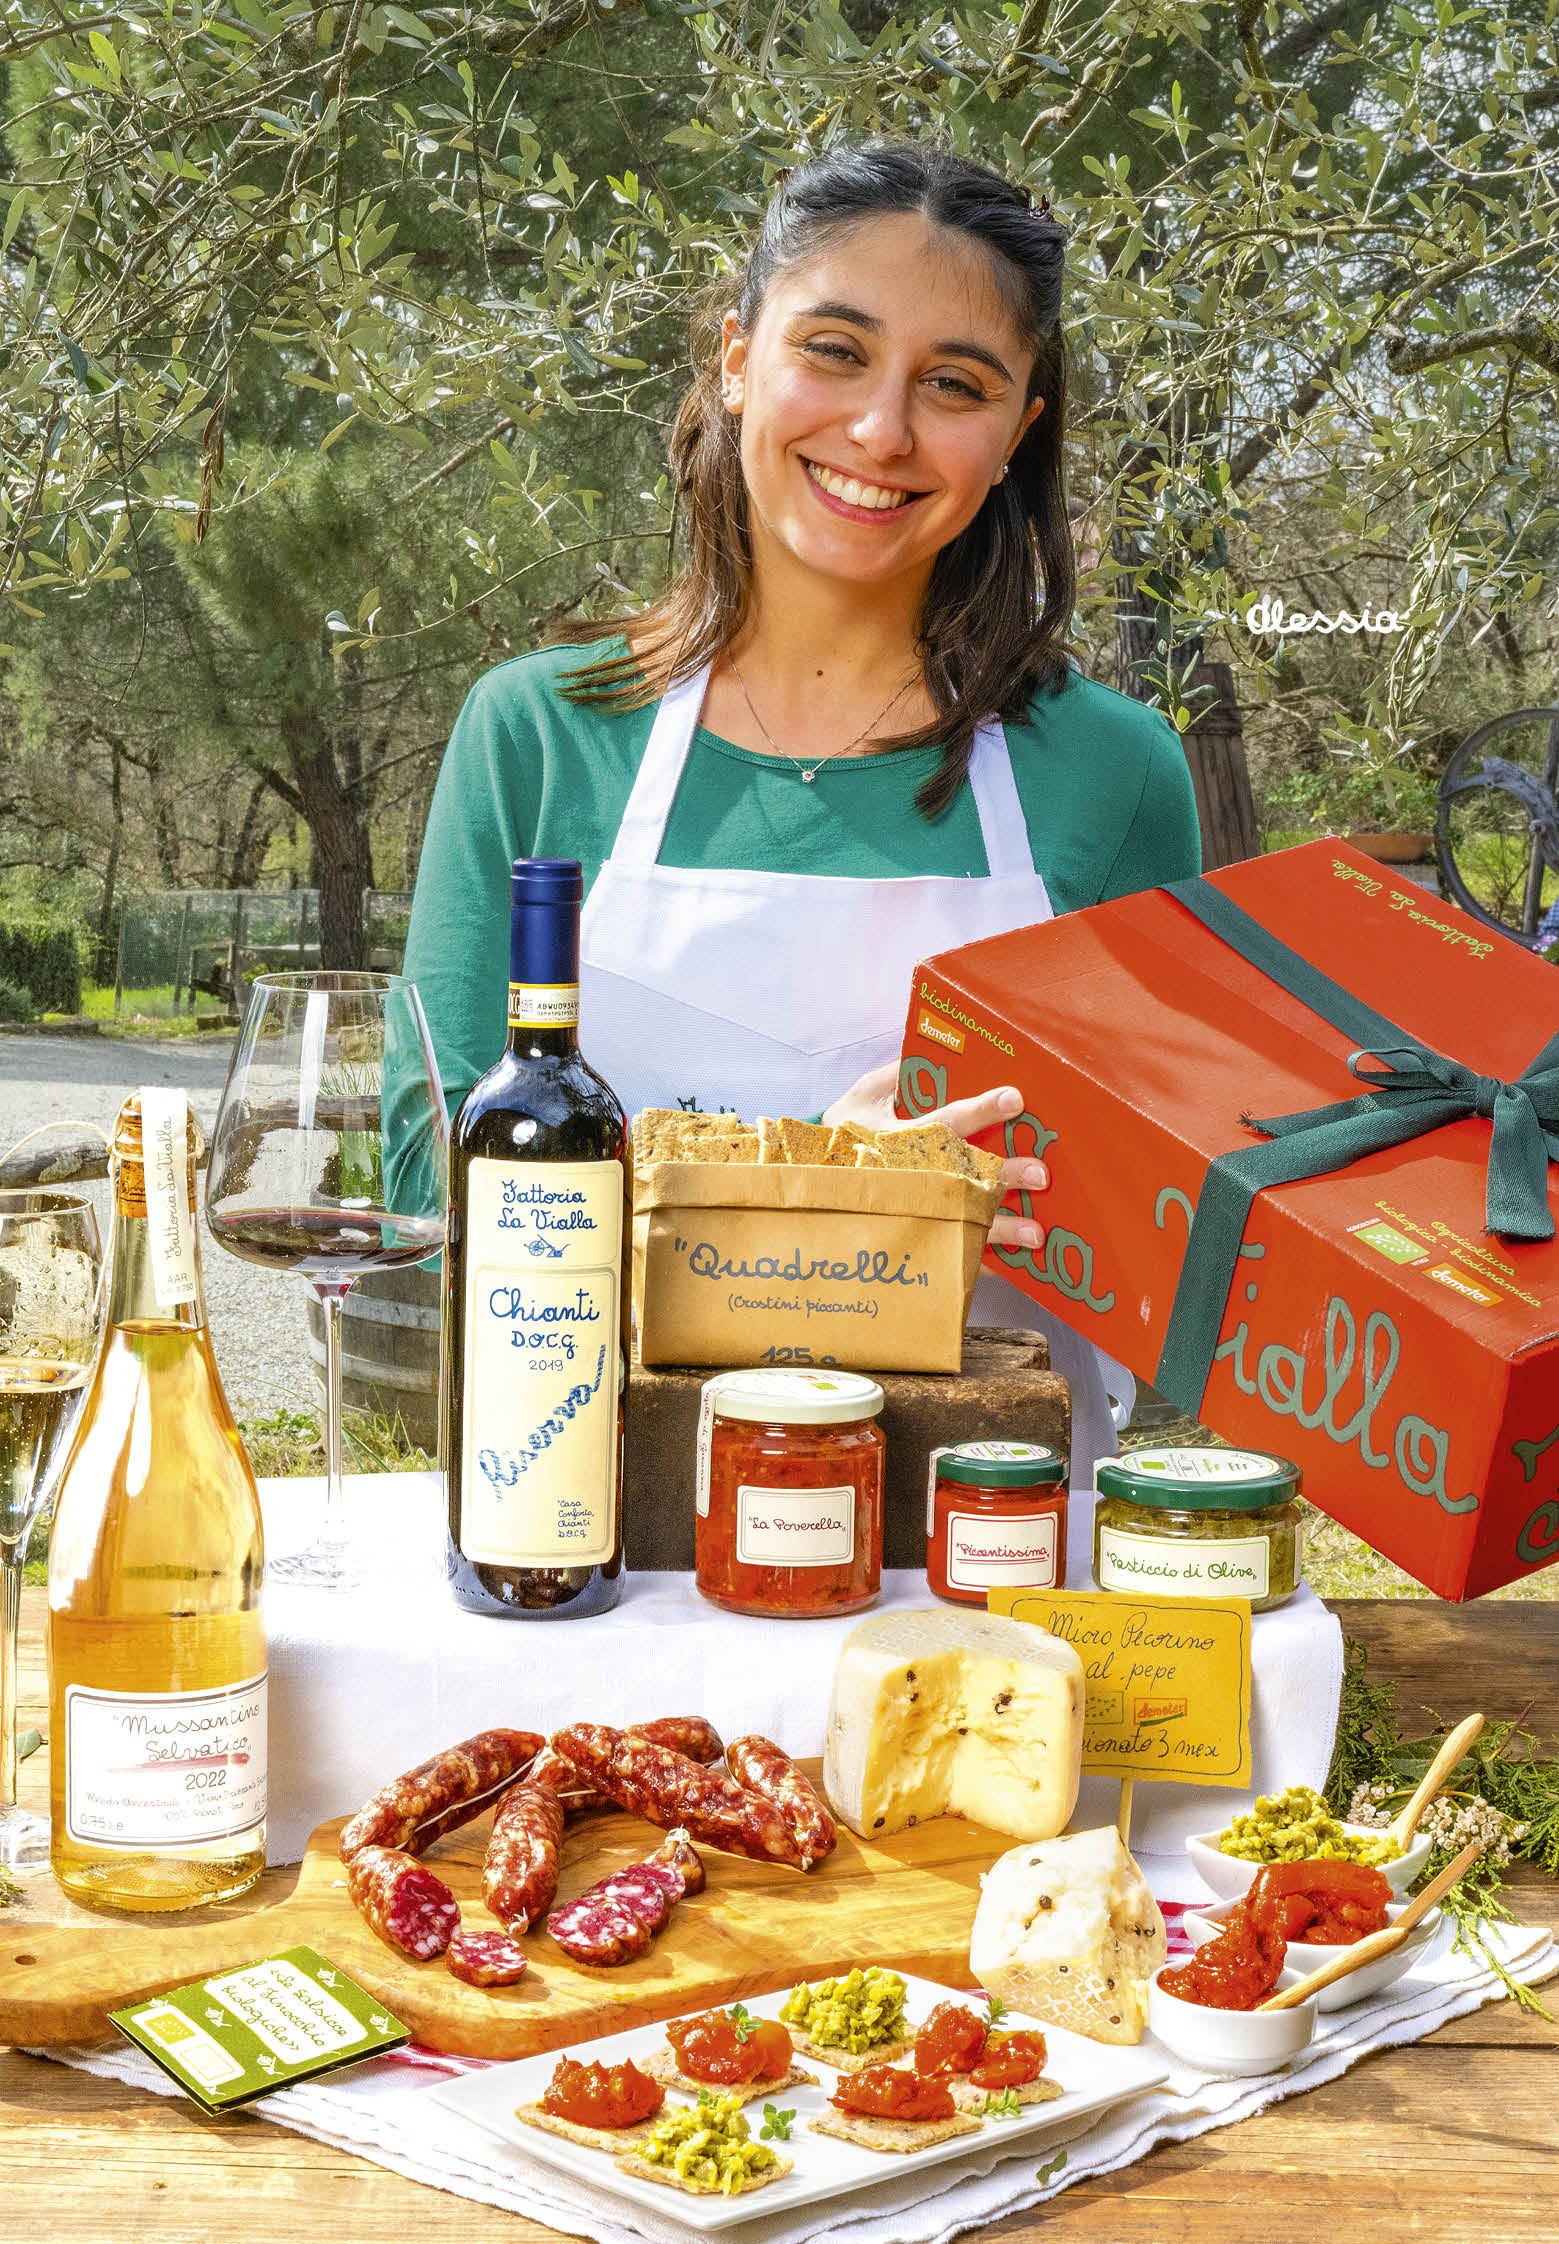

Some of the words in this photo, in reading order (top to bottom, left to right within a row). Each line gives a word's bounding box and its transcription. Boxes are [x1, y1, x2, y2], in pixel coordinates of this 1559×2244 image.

[919, 982, 1015, 1057] biodinamica
[920, 1016, 961, 1048] demeter
[502, 1180, 587, 1204] Fattoria
[497, 1206, 526, 1229] La
[530, 1208, 598, 1231] Vialla
[1374, 1200, 1438, 1245] biologica
[1448, 1248, 1543, 1309] biodinamica
[1430, 1220, 1516, 1277] Agricoltura
[1430, 1268, 1491, 1303] demeter
[489, 1286, 600, 1322] Chianti
[528, 1359, 564, 1372] 2019
[558, 1519, 591, 1528] Chianti
[1183, 1559, 1200, 1579] di
[1120, 1611, 1216, 1650] Pecorino
[1086, 1651, 1115, 1680] al
[1157, 1729, 1170, 1758] 3
[185, 1769, 227, 1791] 2022
[240, 1975, 261, 1990] al
[293, 1984, 348, 2038] Salsicce
